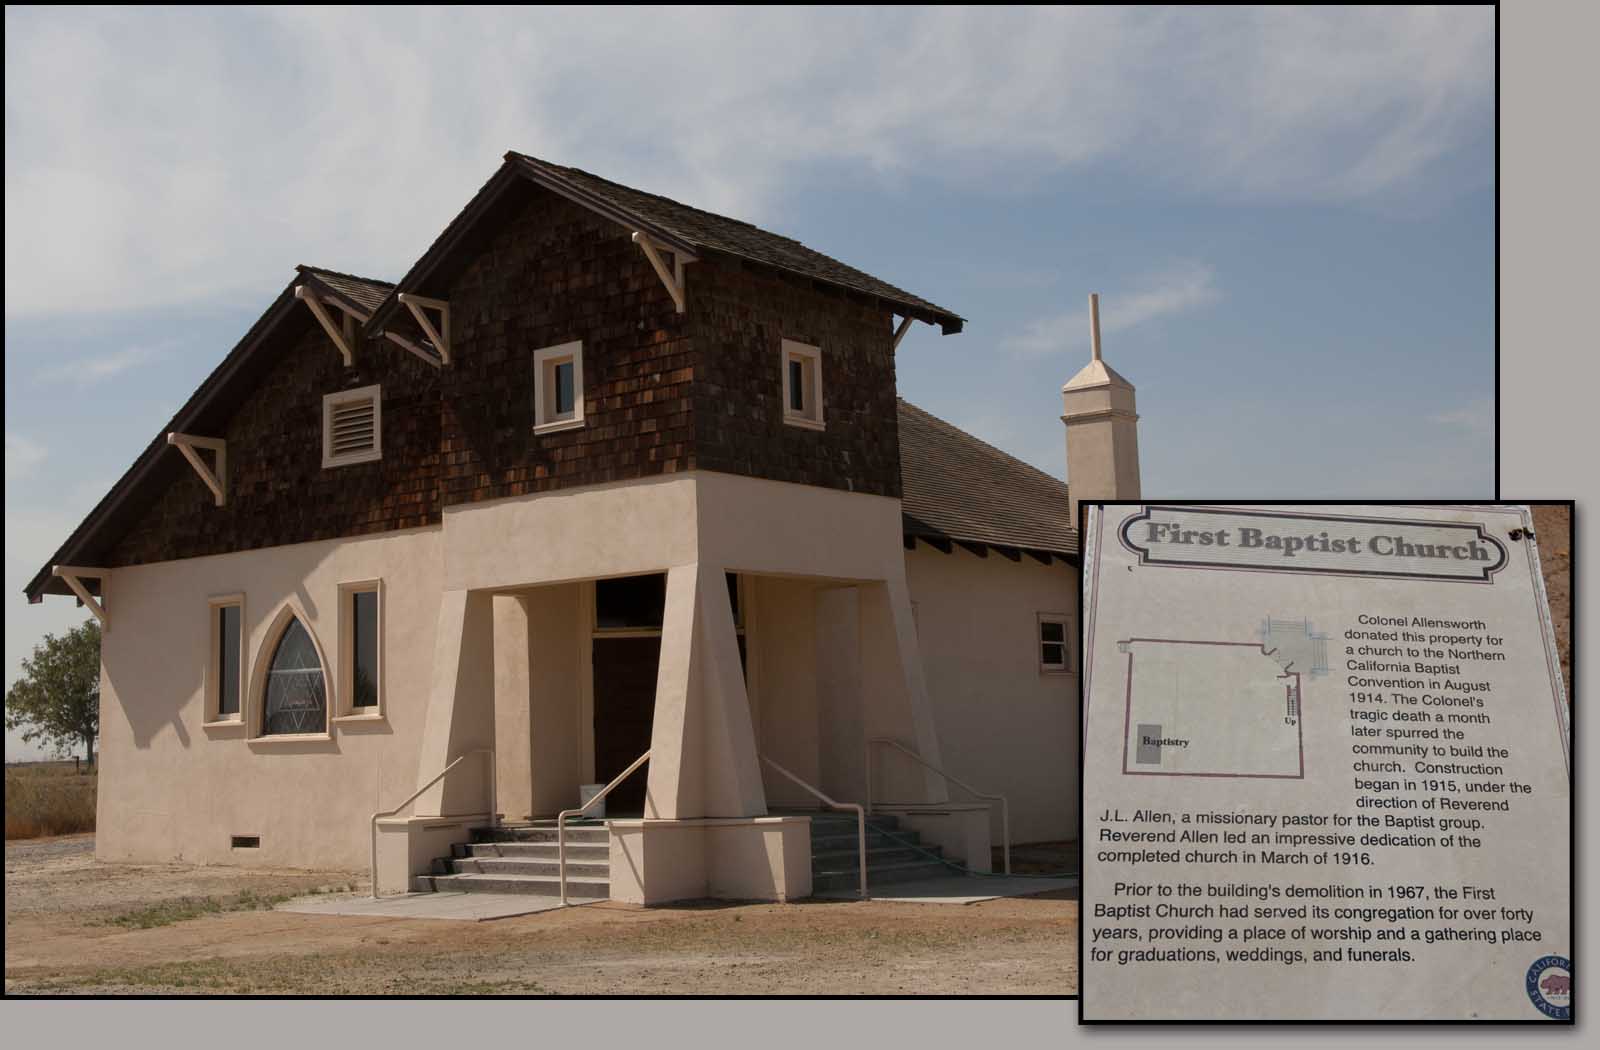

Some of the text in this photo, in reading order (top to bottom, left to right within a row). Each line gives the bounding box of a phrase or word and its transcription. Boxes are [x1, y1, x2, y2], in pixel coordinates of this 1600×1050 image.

[1146, 522, 1490, 561] First Baptist Church
[1358, 614, 1486, 630] Colonel Allensworth
[1344, 629, 1503, 647] donated this property for
[1346, 645, 1505, 660] a church to the Northern
[1347, 659, 1460, 676] California Baptist
[1348, 676, 1491, 693] Convention in August
[1350, 692, 1484, 707] 1914. The Colonel's
[1285, 717, 1296, 726] Up
[1350, 709, 1490, 724] tragic death a month
[1351, 725, 1464, 740] later spurred the
[1143, 736, 1189, 748] Baptistry
[1352, 744, 1508, 759] community to build the
[1353, 760, 1503, 775] church. Construction
[1355, 777, 1531, 794] began in 1915, under the
[1356, 796, 1509, 811] direction of Reverend
[1100, 809, 1484, 831] J.L. Allen, a missionary pastor for the Baptist group.
[1100, 828, 1481, 848] Reverend Allen led an impressive dedication of the
[1097, 849, 1374, 865] completed church in March of 1916.
[1115, 882, 1495, 901] Prior to the building's demolition in 1967, the First
[1094, 904, 1533, 924] Baptist Church had served its congregation for over forty
[1092, 925, 1541, 944] years, providing a place of worship and a gathering place
[1091, 947, 1415, 965] for graduations, weddings, and funerals.
[1530, 990, 1561, 1017] STATE
